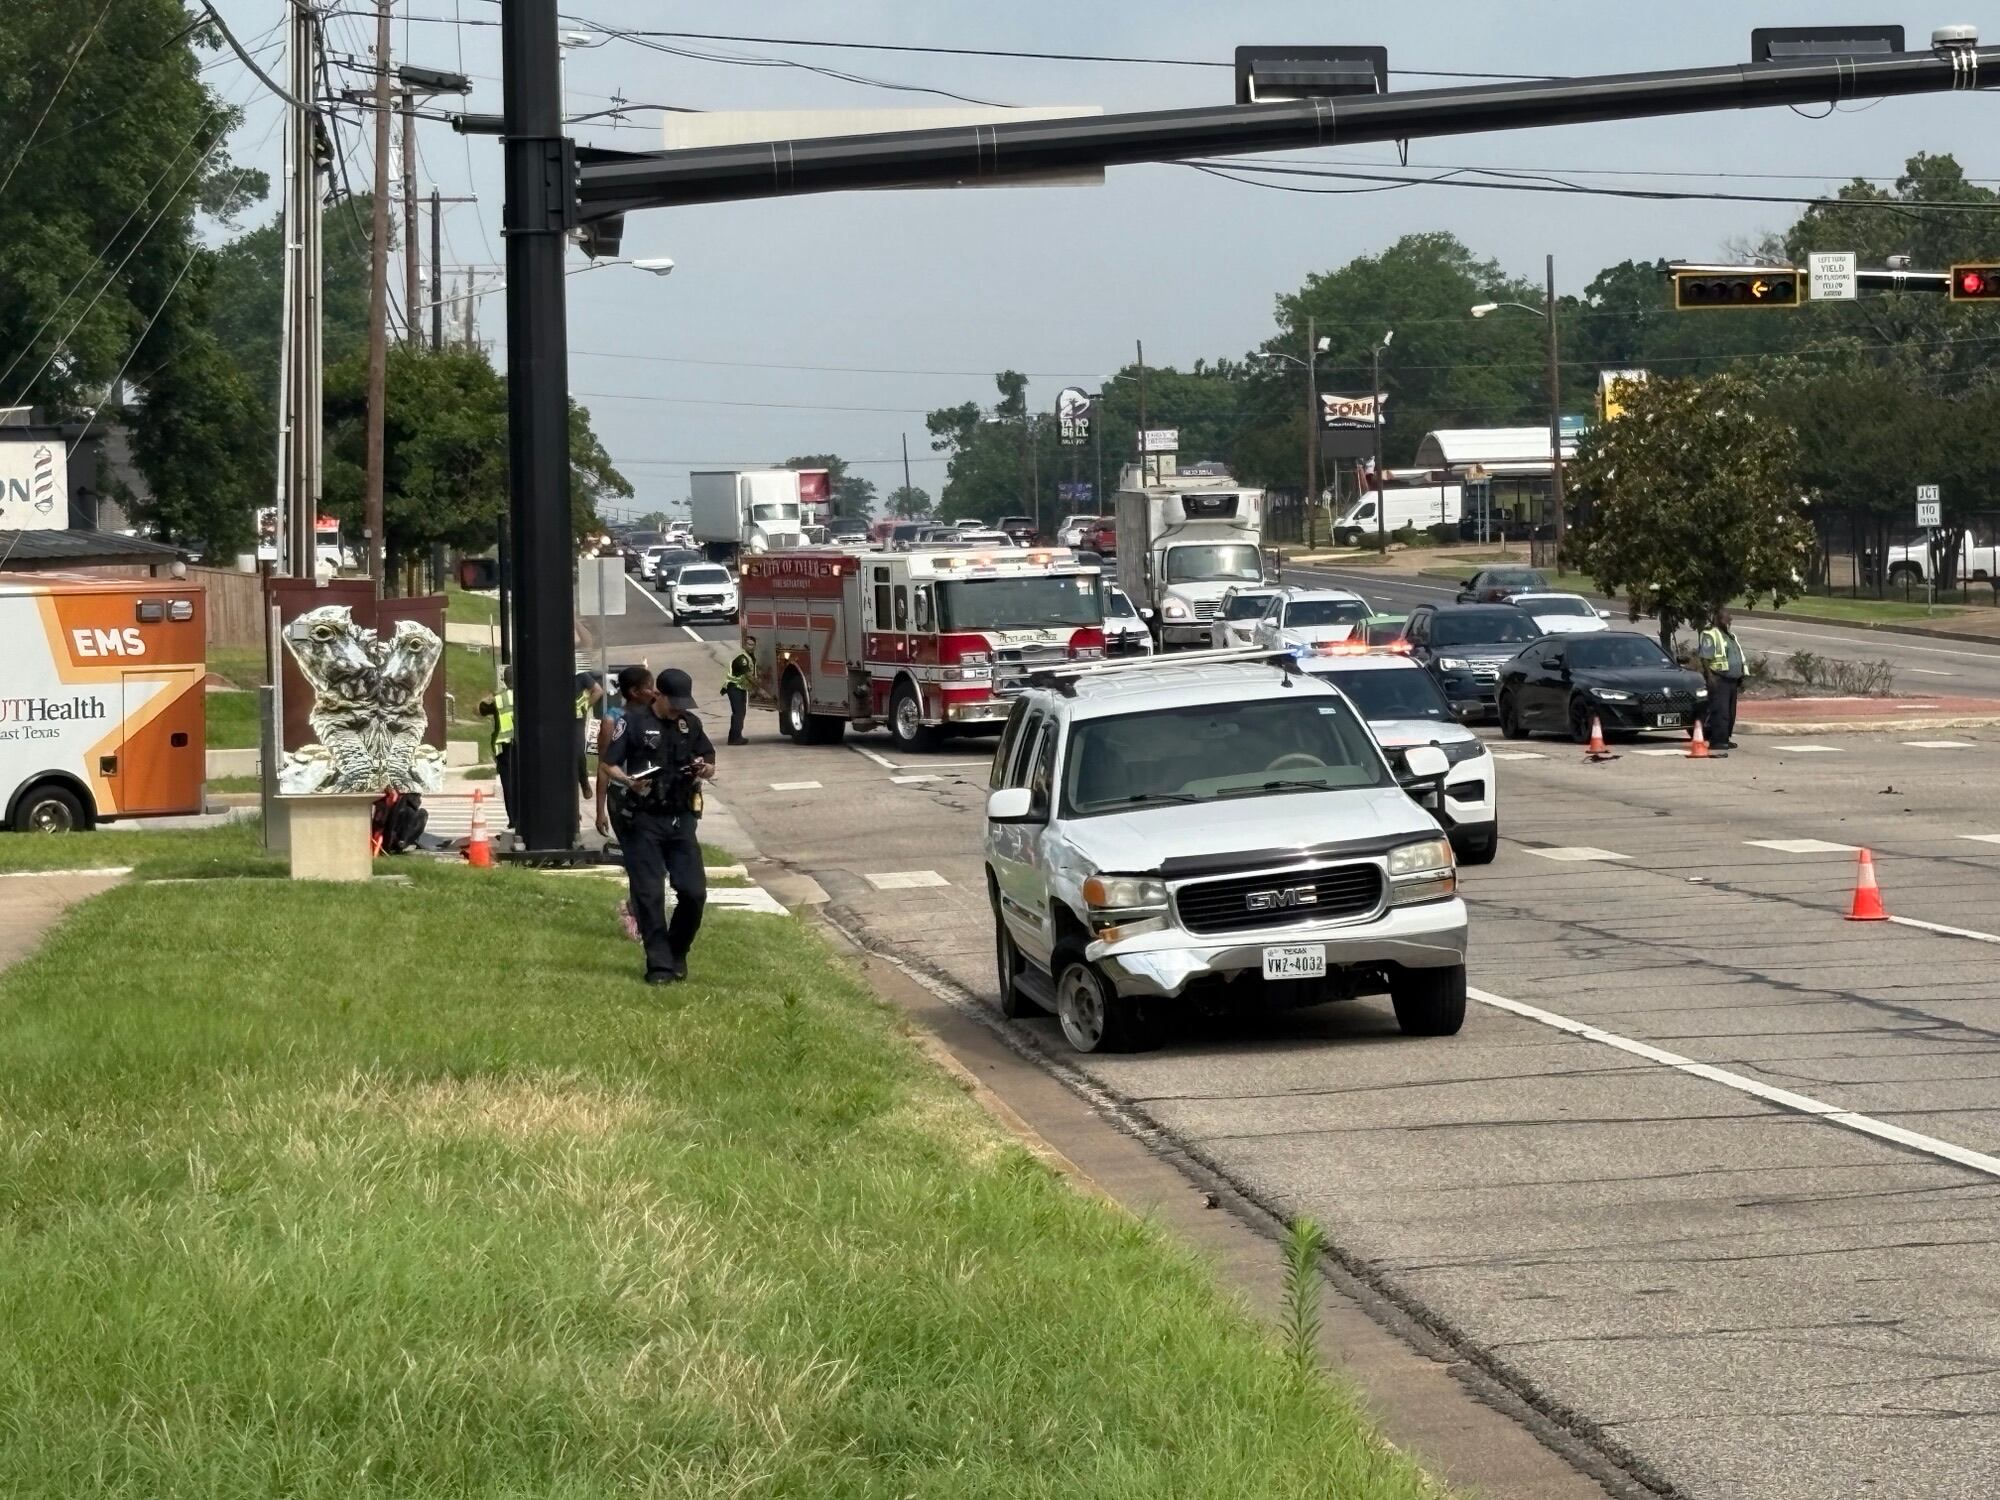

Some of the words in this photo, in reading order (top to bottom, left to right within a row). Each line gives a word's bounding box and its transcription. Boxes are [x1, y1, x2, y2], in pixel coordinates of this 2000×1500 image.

[1821, 264, 1845, 272] YIELD
[1327, 402, 1383, 416] SONI
[1919, 486, 1938, 499] JCT
[1921, 505, 1936, 515] 110
[782, 560, 793, 573] OF
[72, 627, 147, 657] EMS
[22, 725, 60, 740] Texas
[1246, 885, 1318, 911] GMC
